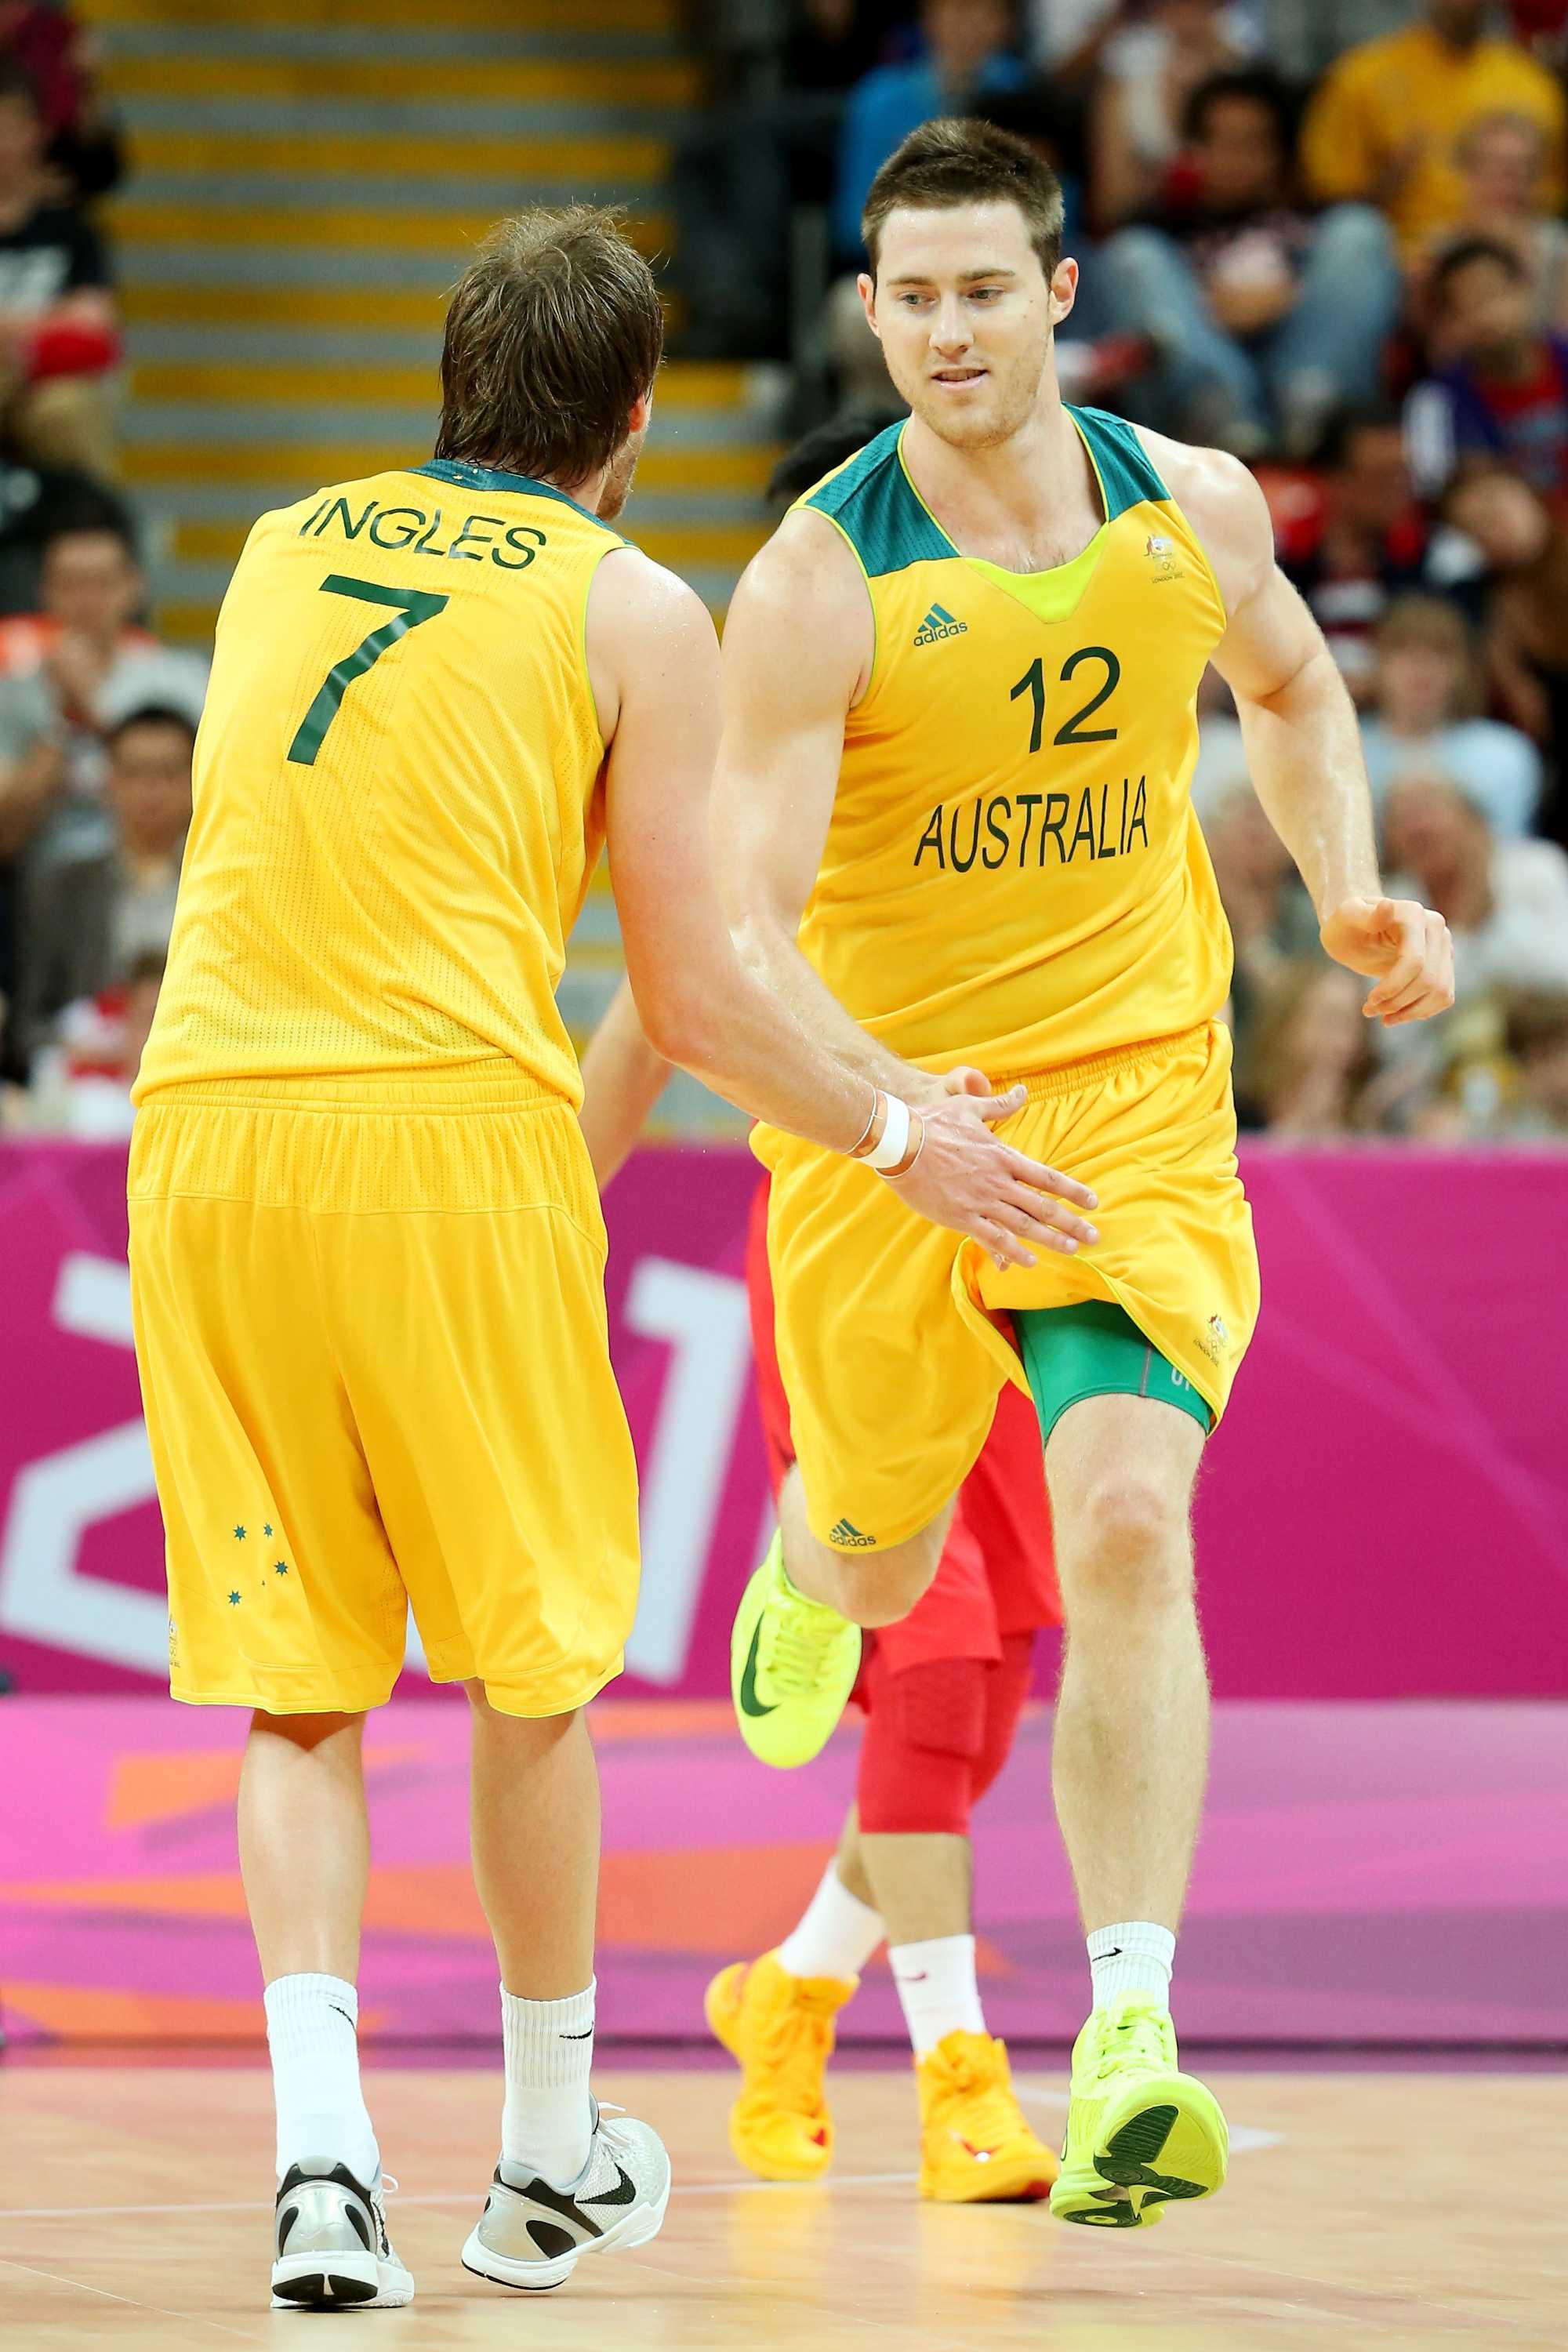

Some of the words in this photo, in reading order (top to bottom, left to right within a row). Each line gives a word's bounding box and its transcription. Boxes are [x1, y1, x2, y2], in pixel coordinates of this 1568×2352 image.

[299, 497, 547, 570] INGLES
[287, 574, 451, 766] 7
[913, 620, 968, 647] adidas
[1010, 646, 1121, 753] 12
[913, 775, 1149, 873] AUSTRALIA
[829, 1534, 877, 1547] adidas
